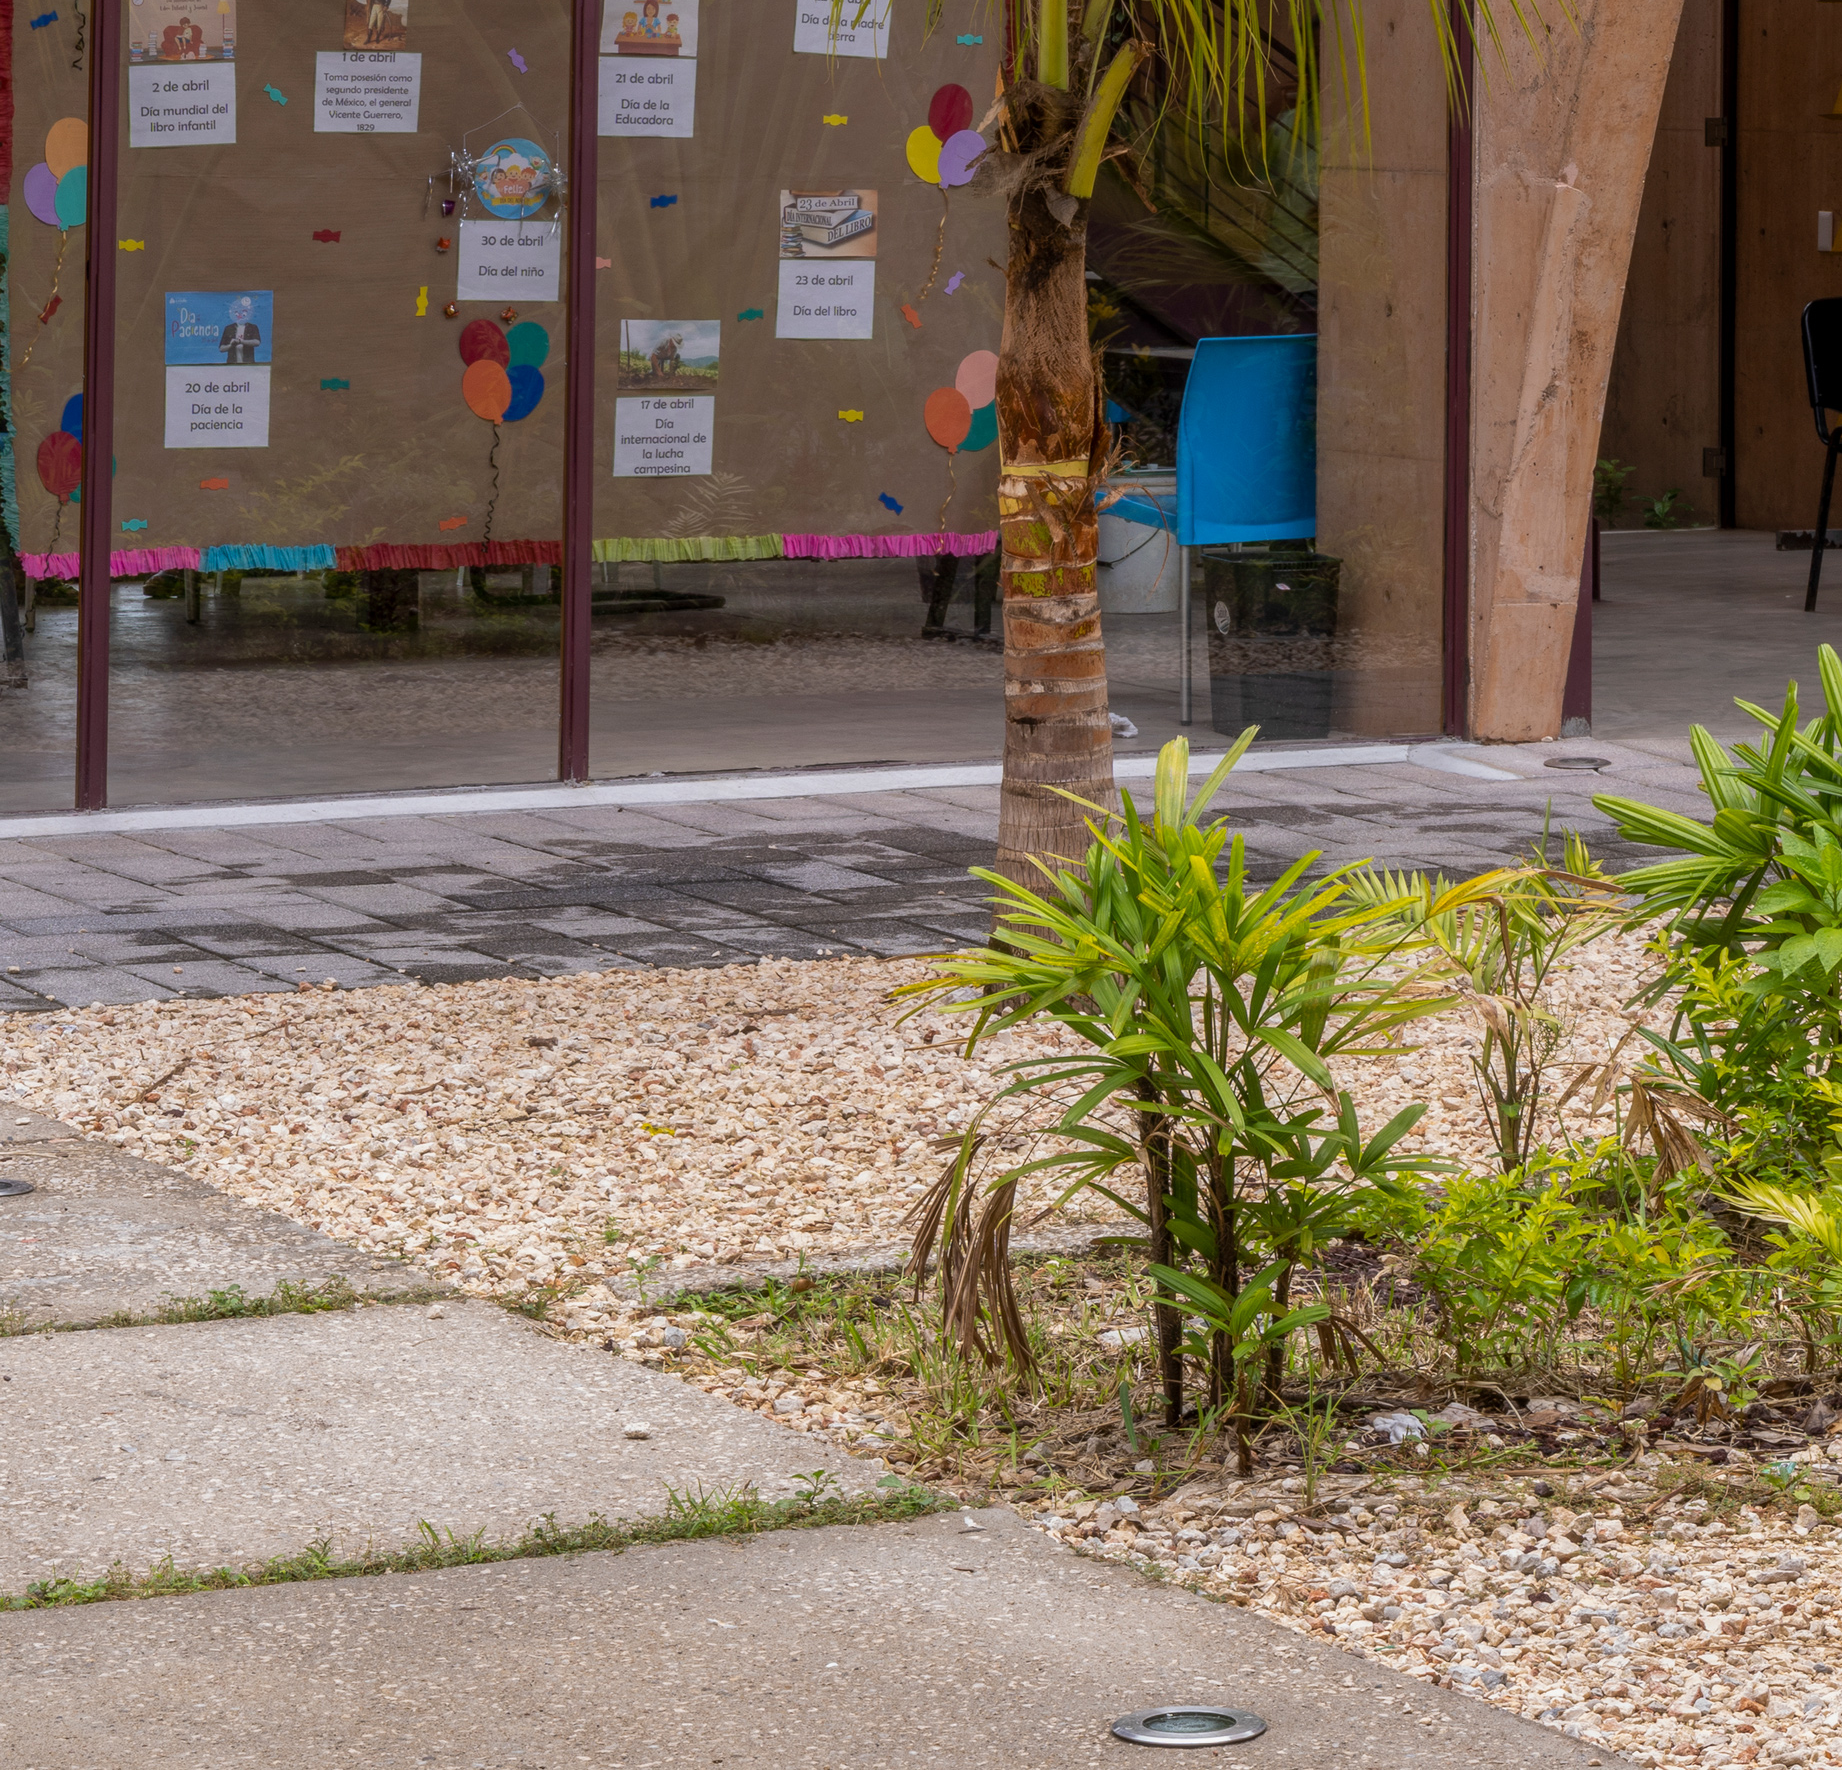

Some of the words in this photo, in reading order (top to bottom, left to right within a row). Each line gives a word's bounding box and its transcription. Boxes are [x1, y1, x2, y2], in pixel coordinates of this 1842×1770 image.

[801, 13, 819, 25] Día
[342, 52, 346, 62] 1
[350, 52, 365, 62] de
[368, 52, 396, 63] abril
[324, 73, 349, 81] Toma
[350, 73, 387, 83] posesión
[615, 74, 626, 83] 21
[629, 73, 644, 84] de
[647, 73, 674, 84] abril
[152, 83, 160, 93] 2
[163, 81, 179, 92] de
[182, 79, 209, 92] abril
[326, 86, 362, 95] segundo
[364, 86, 409, 95] presidente
[322, 98, 333, 106] de
[335, 98, 367, 108] México,
[369, 98, 377, 106] el
[378, 99, 412, 108] general
[621, 99, 640, 110] Día
[643, 99, 657, 110] de
[659, 100, 670, 111] la
[141, 106, 160, 117] Día
[163, 104, 209, 116] mundial
[212, 103, 228, 114] del
[328, 110, 361, 119] Vicente
[363, 110, 403, 120] Guerrero,
[615, 114, 674, 125] Educadora
[150, 122, 175, 133] libro
[178, 120, 216, 131] infantil
[800, 199, 812, 211] 23
[829, 198, 855, 207] Abril
[796, 212, 832, 226] INTERNACIONAL
[827, 226, 845, 242] DEL
[845, 216, 871, 235] LIBRO
[481, 236, 497, 246] 30
[499, 235, 514, 246] de
[517, 235, 544, 247] abril
[478, 265, 498, 276] Día
[501, 265, 518, 277] del
[520, 267, 544, 277] niño
[795, 276, 808, 285] 23
[811, 275, 825, 285] de
[828, 275, 854, 286] abril
[793, 305, 811, 316] Día
[814, 306, 831, 316] del
[834, 306, 857, 317] libro
[185, 383, 201, 393] 20
[204, 382, 219, 393] de
[223, 381, 250, 393] abril
[191, 403, 211, 414] Día
[214, 404, 229, 414] de
[232, 403, 243, 414] la
[641, 400, 651, 410] 17
[653, 399, 667, 409] de
[670, 398, 694, 409] abril
[190, 420, 243, 432] paciencia
[655, 418, 674, 429] Día
[620, 433, 690, 445] internacional
[692, 433, 707, 443] de
[642, 449, 652, 459] la
[655, 448, 684, 459] lucha
[634, 463, 691, 475] campesina
